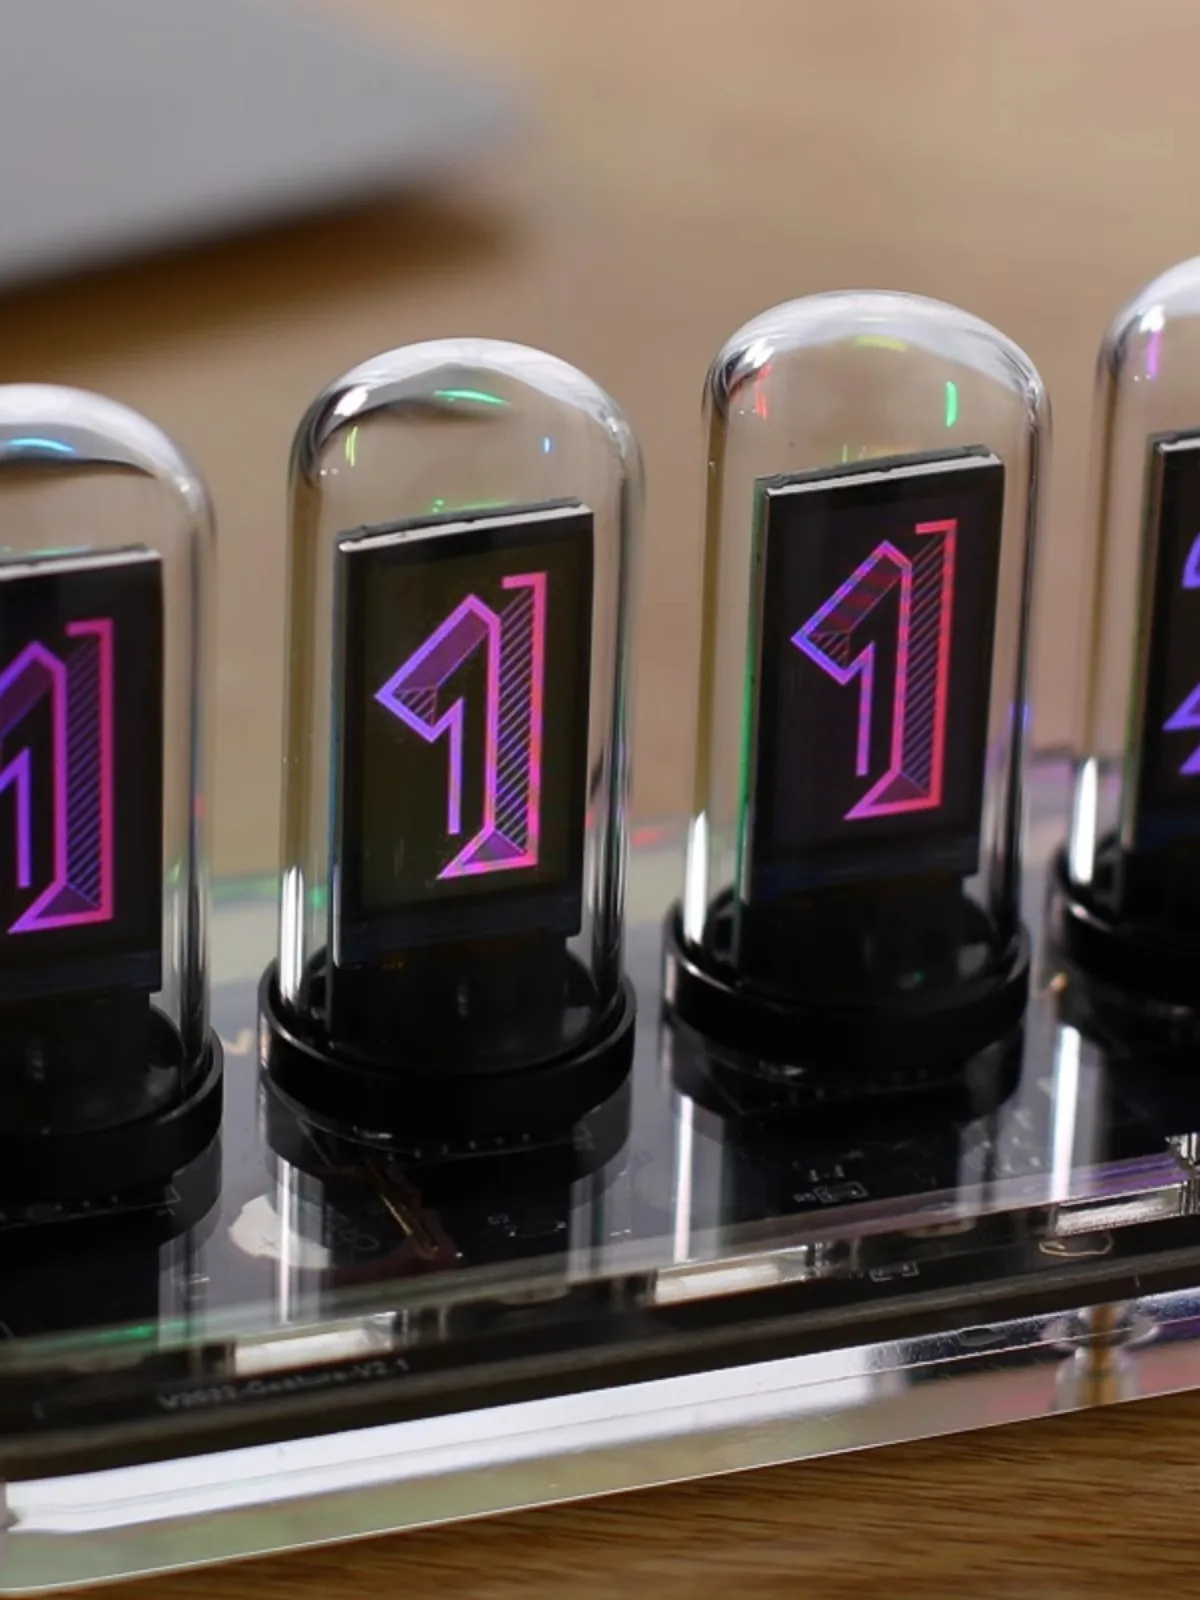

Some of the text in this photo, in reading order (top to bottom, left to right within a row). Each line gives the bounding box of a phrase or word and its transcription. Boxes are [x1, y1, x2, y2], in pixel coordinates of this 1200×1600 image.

[0, 617, 113, 934] 1
[373, 572, 548, 879] 1
[790, 518, 957, 821] 1
